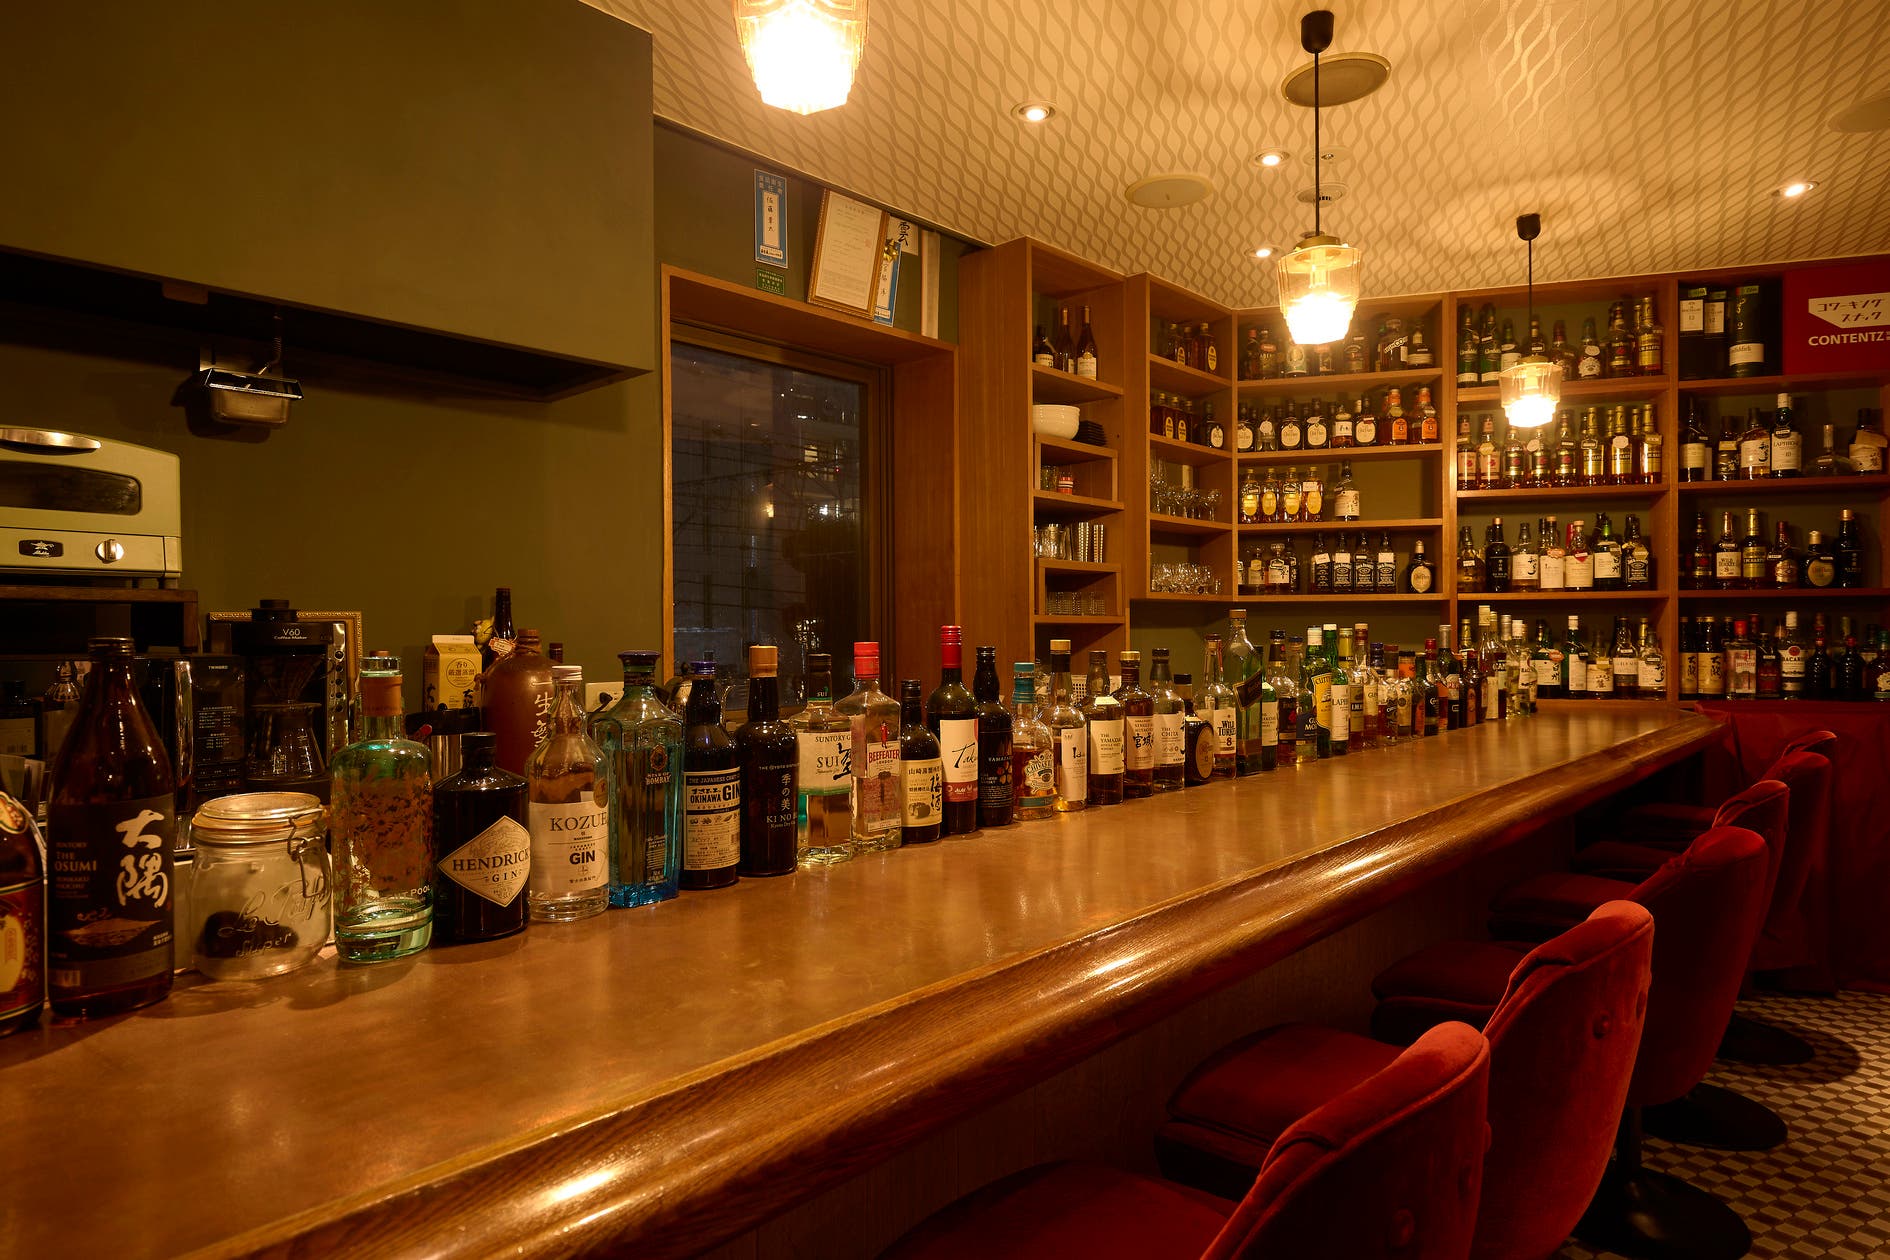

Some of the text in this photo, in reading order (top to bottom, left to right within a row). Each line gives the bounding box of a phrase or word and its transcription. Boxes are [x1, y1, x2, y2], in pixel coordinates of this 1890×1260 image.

[1842, 312, 1882, 323] スナック
[815, 735, 846, 743] SUNTORY
[1226, 737, 1233, 747] 8
[816, 755, 840, 769] SUI
[868, 749, 900, 763] BEEFEATER
[689, 793, 722, 804] OKINAWA
[780, 773, 791, 811] 季の美
[549, 811, 608, 832] KOZUE
[55, 851, 76, 861] THE
[114, 809, 169, 909] 大隅
[569, 850, 596, 866] GIN
[54, 860, 97, 873] OSUMI
[492, 870, 518, 883] GIN
